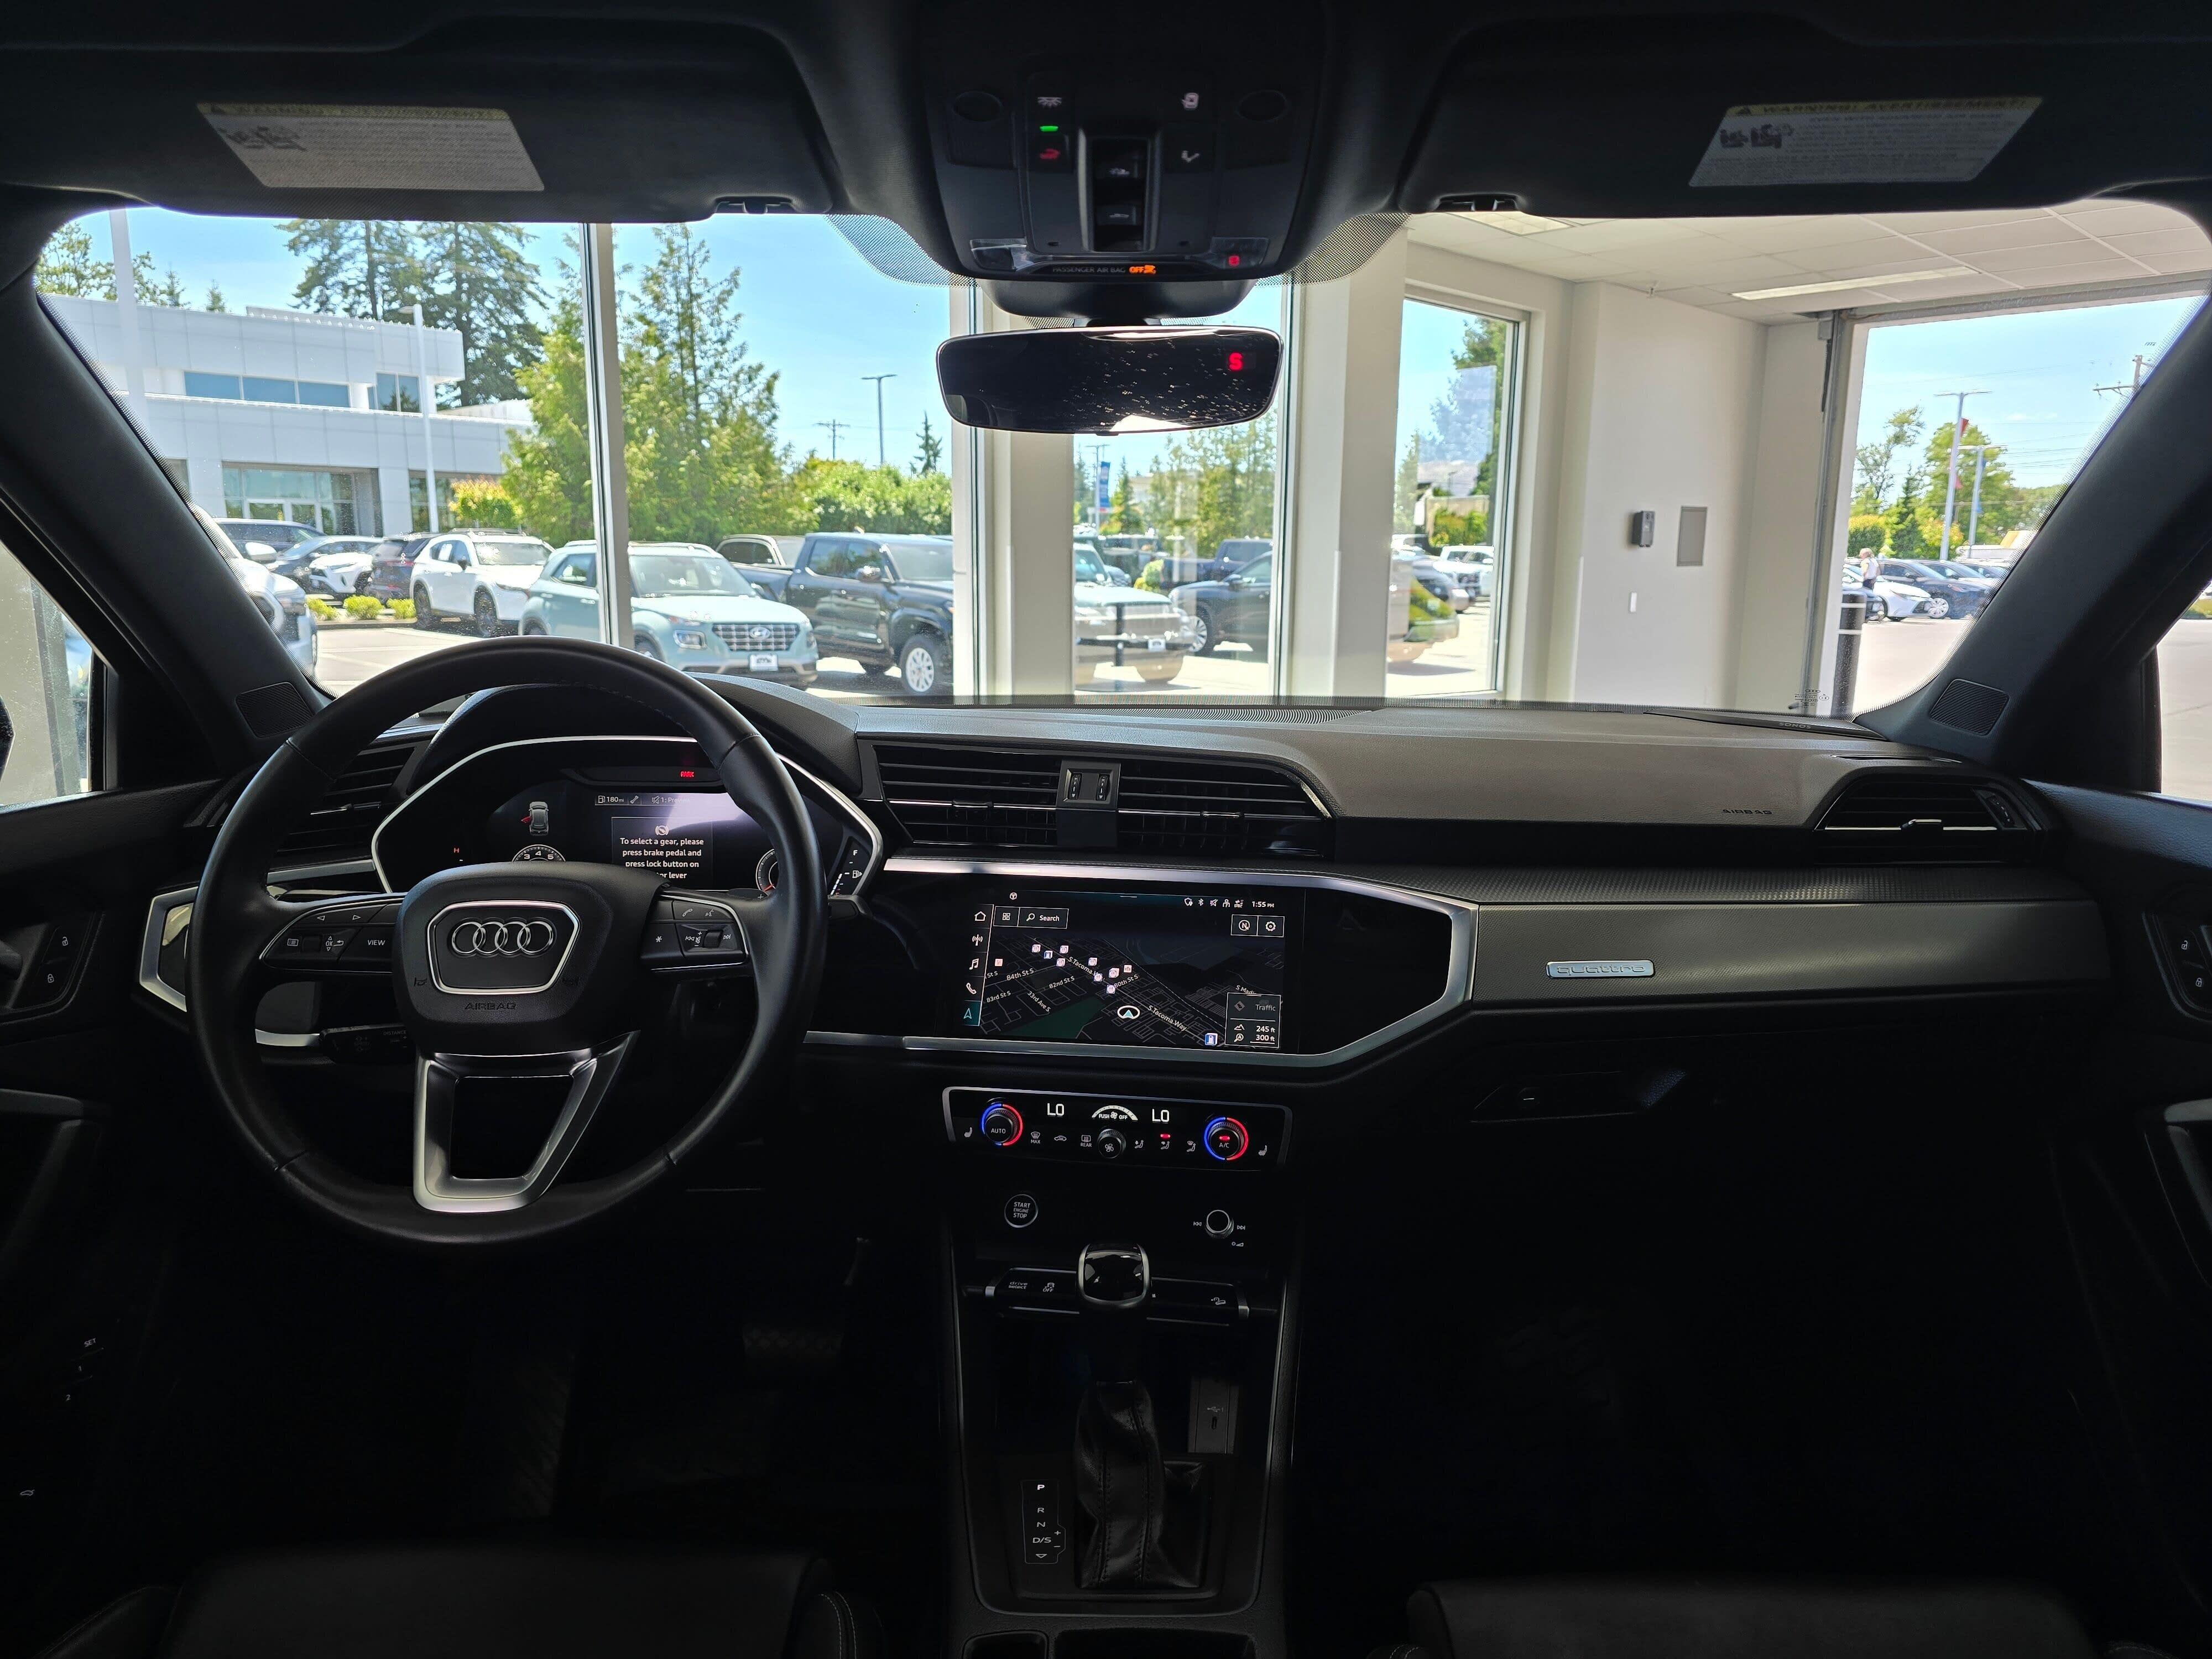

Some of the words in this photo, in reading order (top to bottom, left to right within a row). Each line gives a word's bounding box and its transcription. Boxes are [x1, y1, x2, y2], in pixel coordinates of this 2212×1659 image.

[1229, 352, 1243, 371] S
[1557, 964, 1646, 975] quattro
[1006, 973, 1021, 981] 84th
[1049, 980, 1063, 989] 82nd
[1114, 980, 1127, 988] 80th
[986, 994, 999, 1003] 83rd
[1027, 991, 1040, 1002] 33rd
[1037, 999, 1047, 1009] Ave
[465, 1002, 517, 1010] AIRBAG
[1152, 1007, 1174, 1025] Tacoma
[1172, 1020, 1187, 1031] Way
[1047, 1103, 1065, 1116] LO
[1152, 1108, 1169, 1122] LO
[84, 1338, 96, 1347] SET
